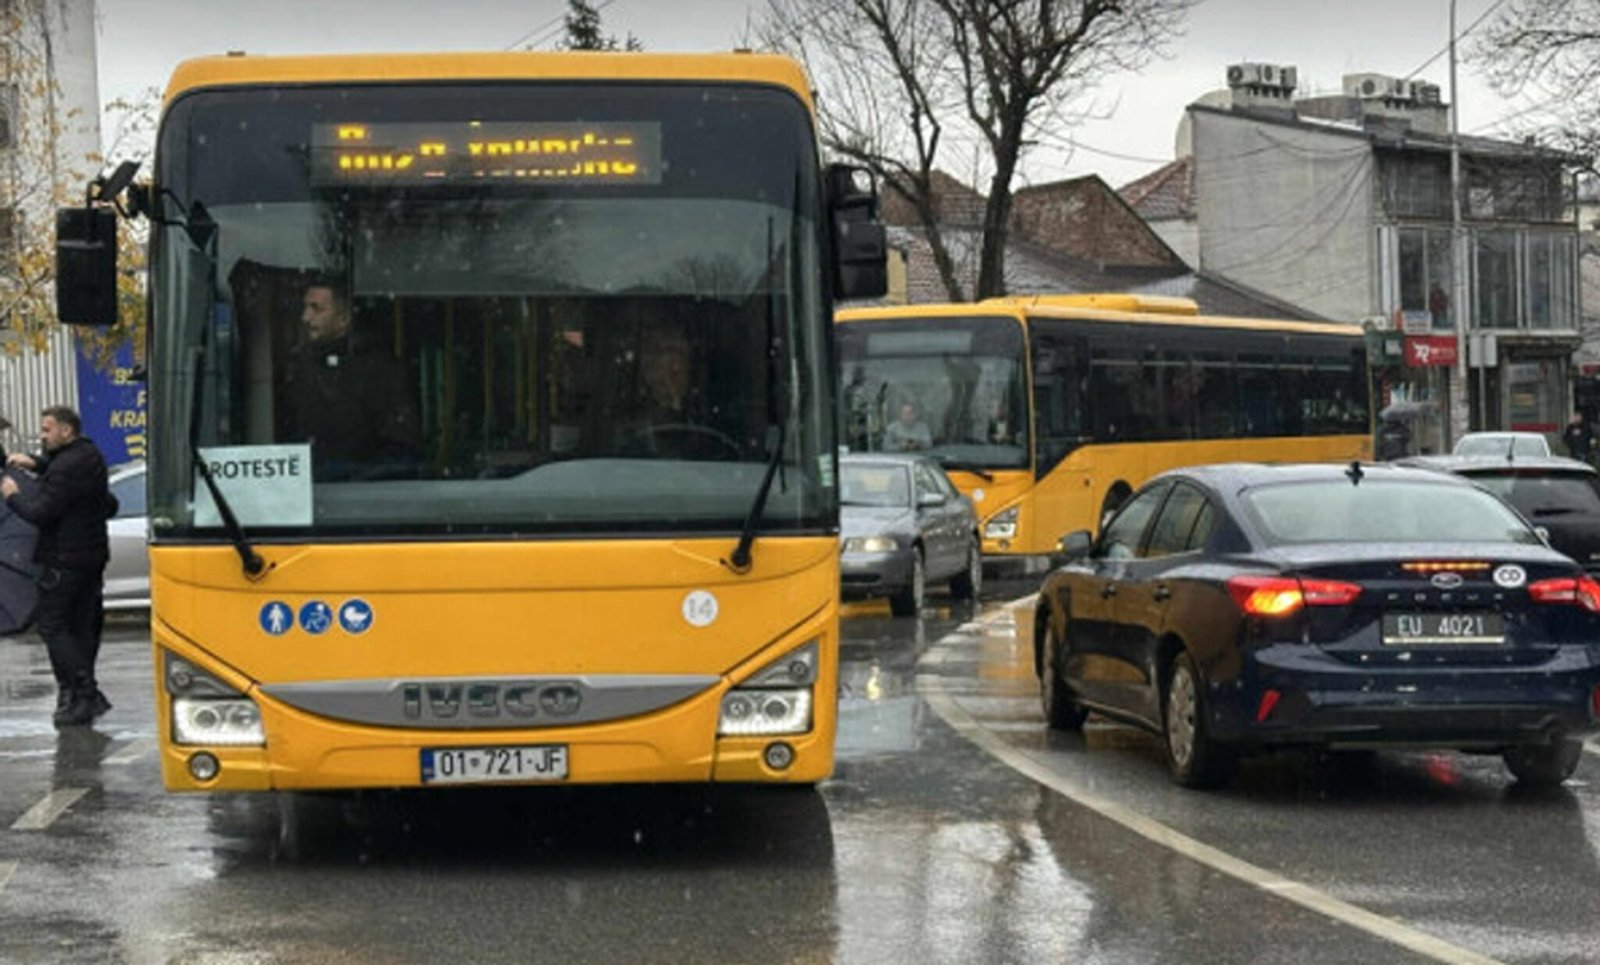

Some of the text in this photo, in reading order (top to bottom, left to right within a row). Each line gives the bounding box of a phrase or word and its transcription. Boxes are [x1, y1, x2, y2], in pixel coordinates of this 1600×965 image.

[688, 597, 713, 619] 14
[1397, 614, 1484, 636] EU 4021
[403, 681, 583, 720] IVECO
